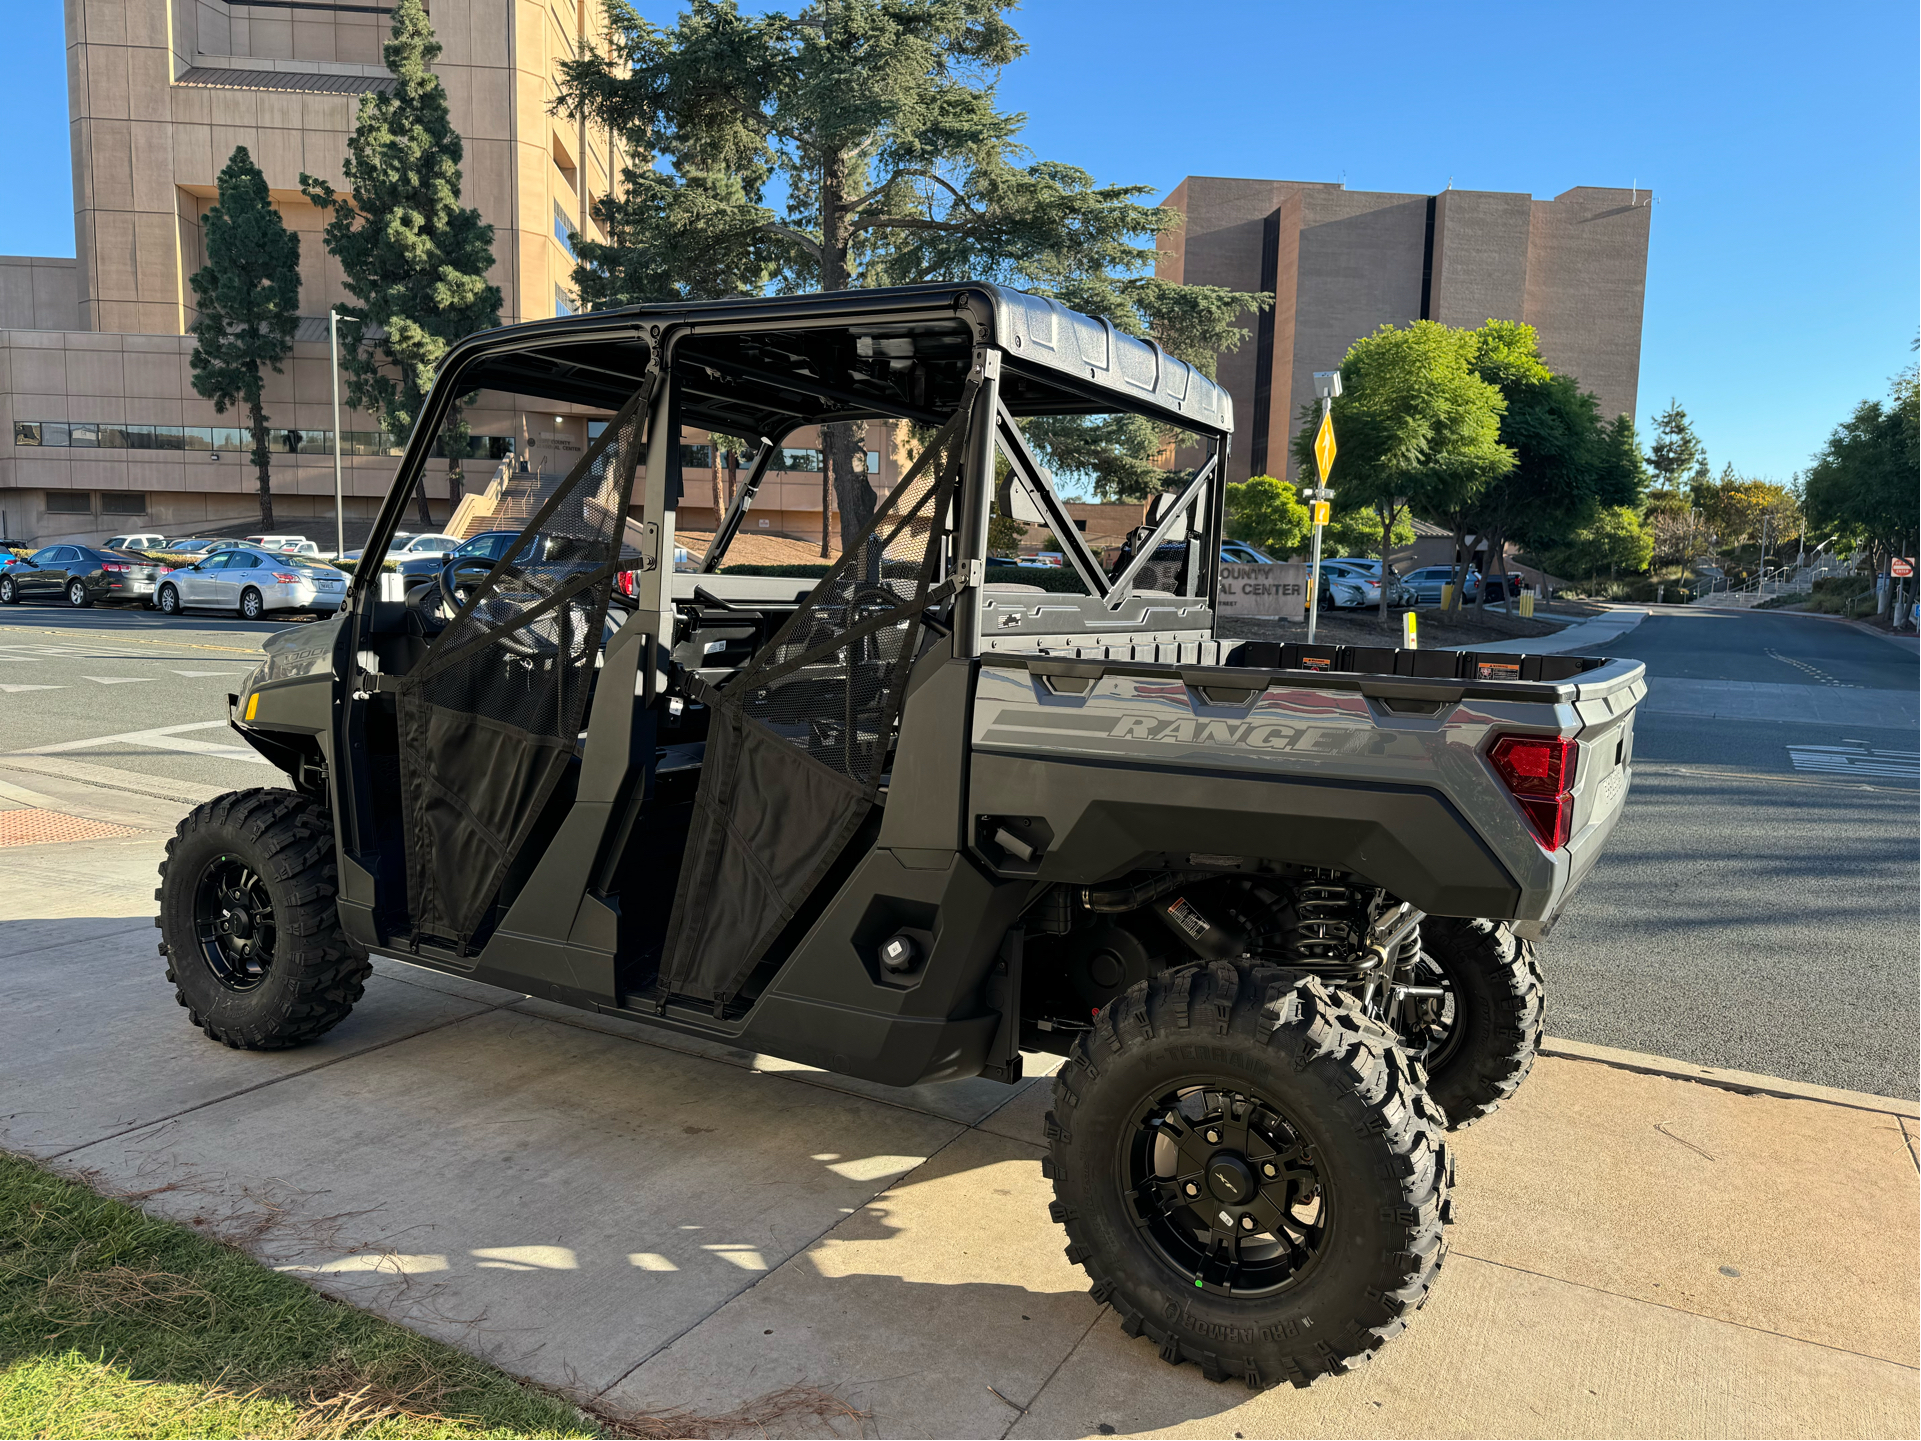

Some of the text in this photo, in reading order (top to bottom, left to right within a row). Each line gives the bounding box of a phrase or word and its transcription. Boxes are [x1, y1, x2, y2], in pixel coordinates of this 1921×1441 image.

[1221, 567, 1273, 580] OUNTY
[1242, 583, 1301, 596] CENTER
[1107, 714, 1399, 756] RANGER
[1140, 1044, 1272, 1081] X-TERRAIN
[1183, 1312, 1300, 1344] PRO ARMOR
